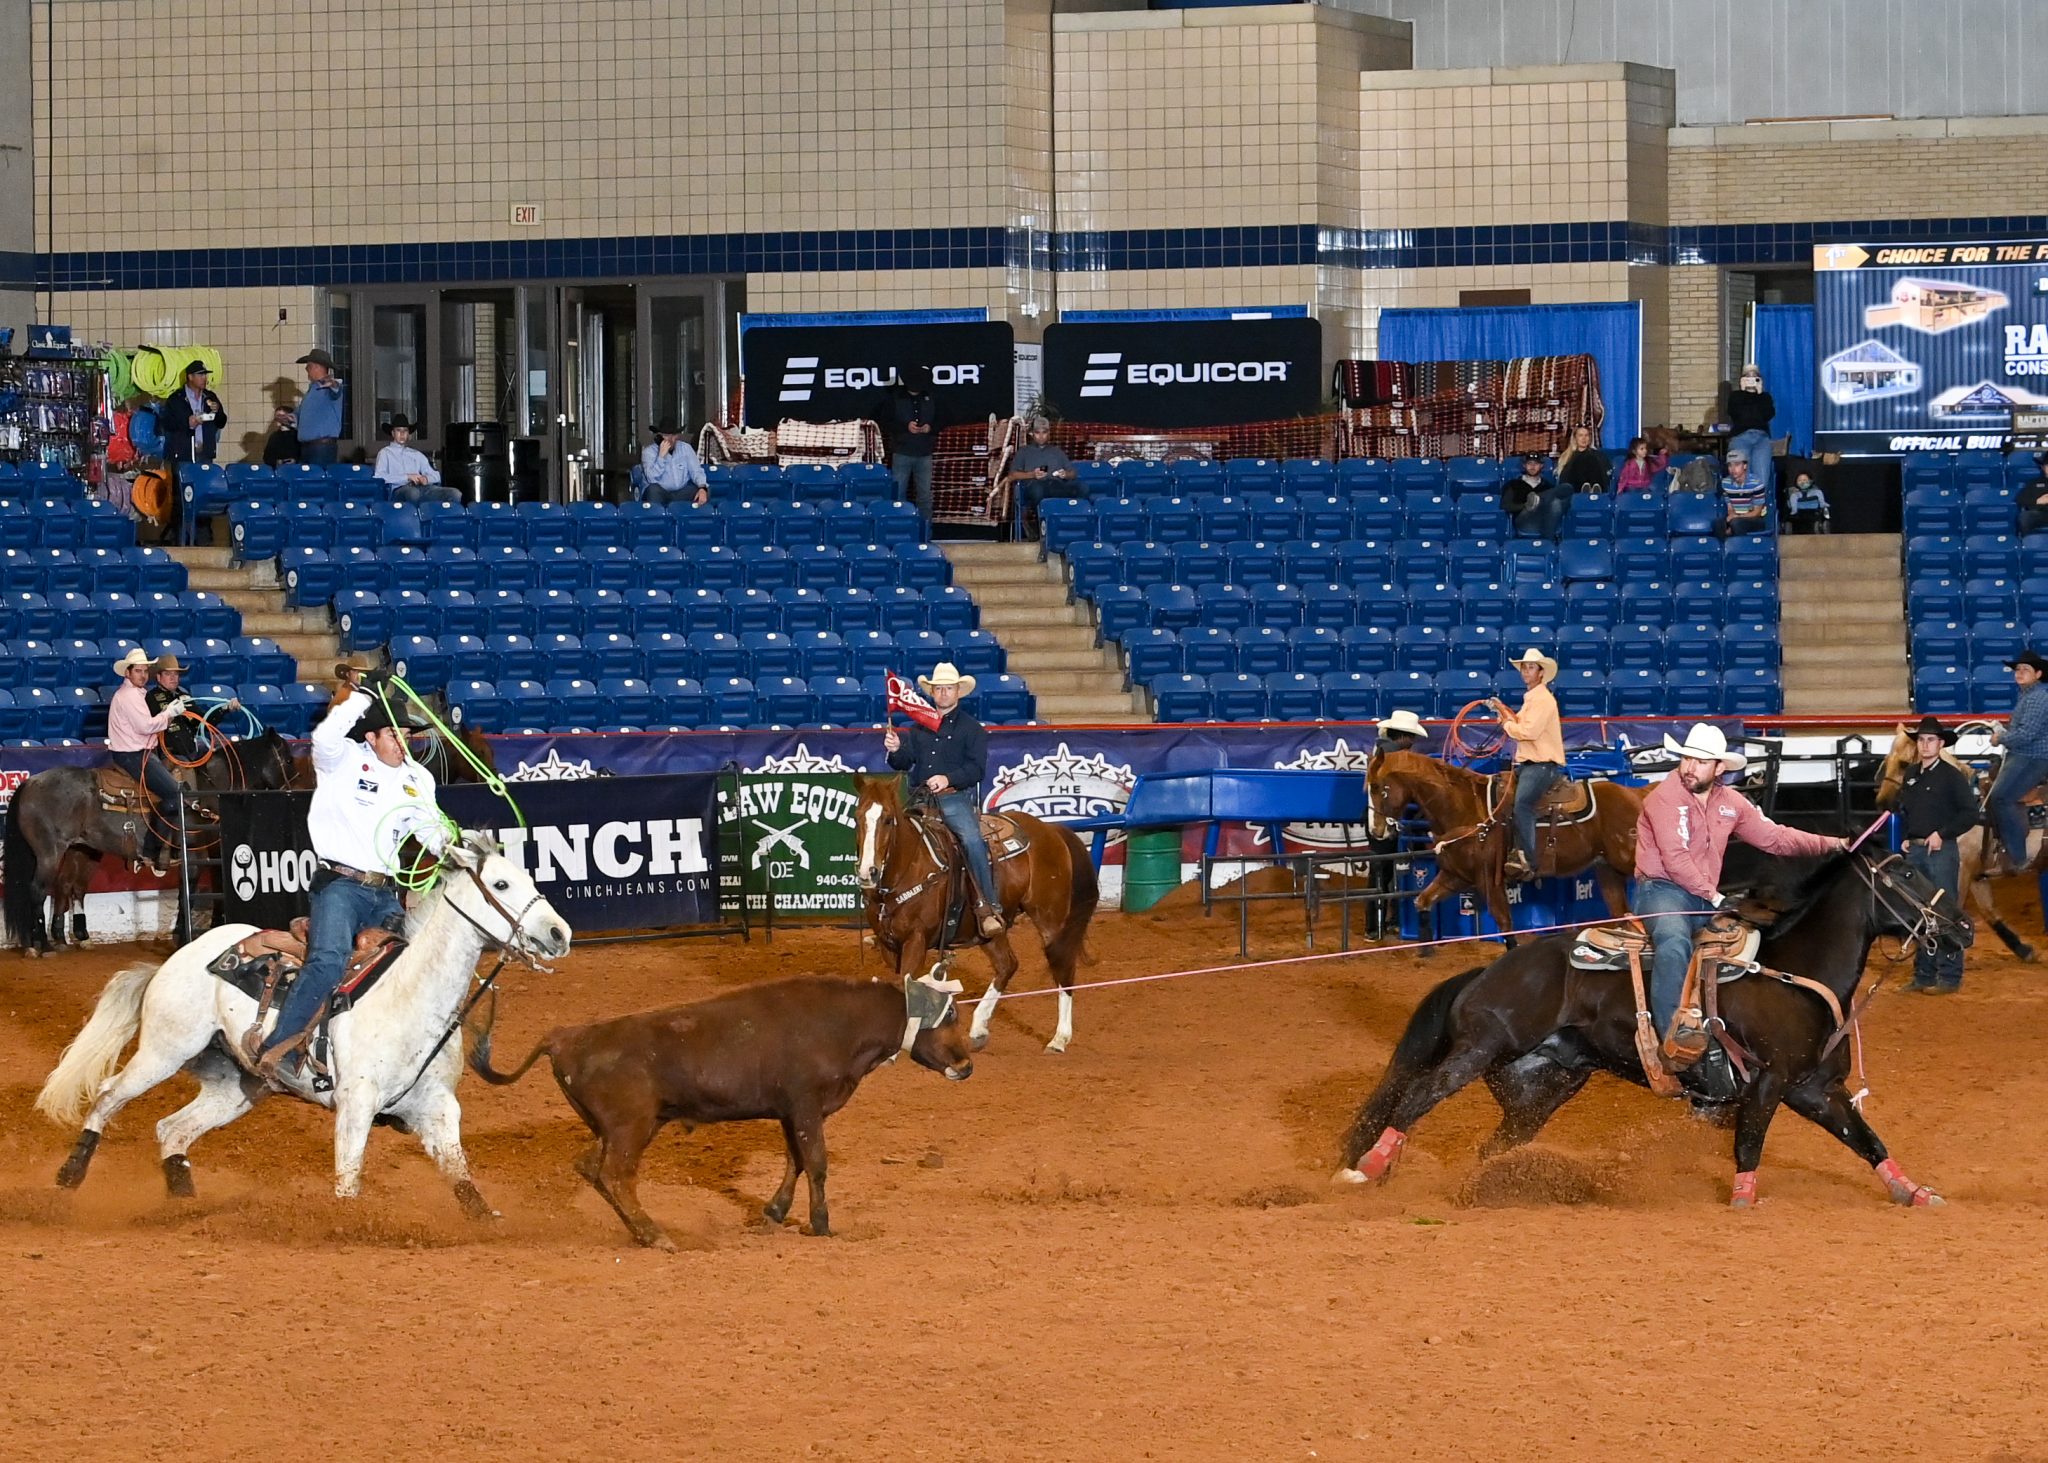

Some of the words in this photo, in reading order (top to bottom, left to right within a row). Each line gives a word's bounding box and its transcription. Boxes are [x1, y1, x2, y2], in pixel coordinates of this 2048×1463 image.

[515, 206, 536, 223] EXIT
[1876, 249, 1945, 264] CHOICE
[1951, 247, 1990, 263] FOR
[1996, 245, 2033, 261] THE
[825, 364, 980, 389] EQUOR
[1127, 361, 1286, 386] EQUICOR
[1889, 436, 1962, 451] OFFICIAL
[1048, 785, 1081, 794] THE
[717, 782, 784, 825] LAW
[499, 818, 708, 882] INCH
[566, 878, 710, 899] CINCHJEANS.COM
[774, 893, 856, 910] CHAMPIONS
